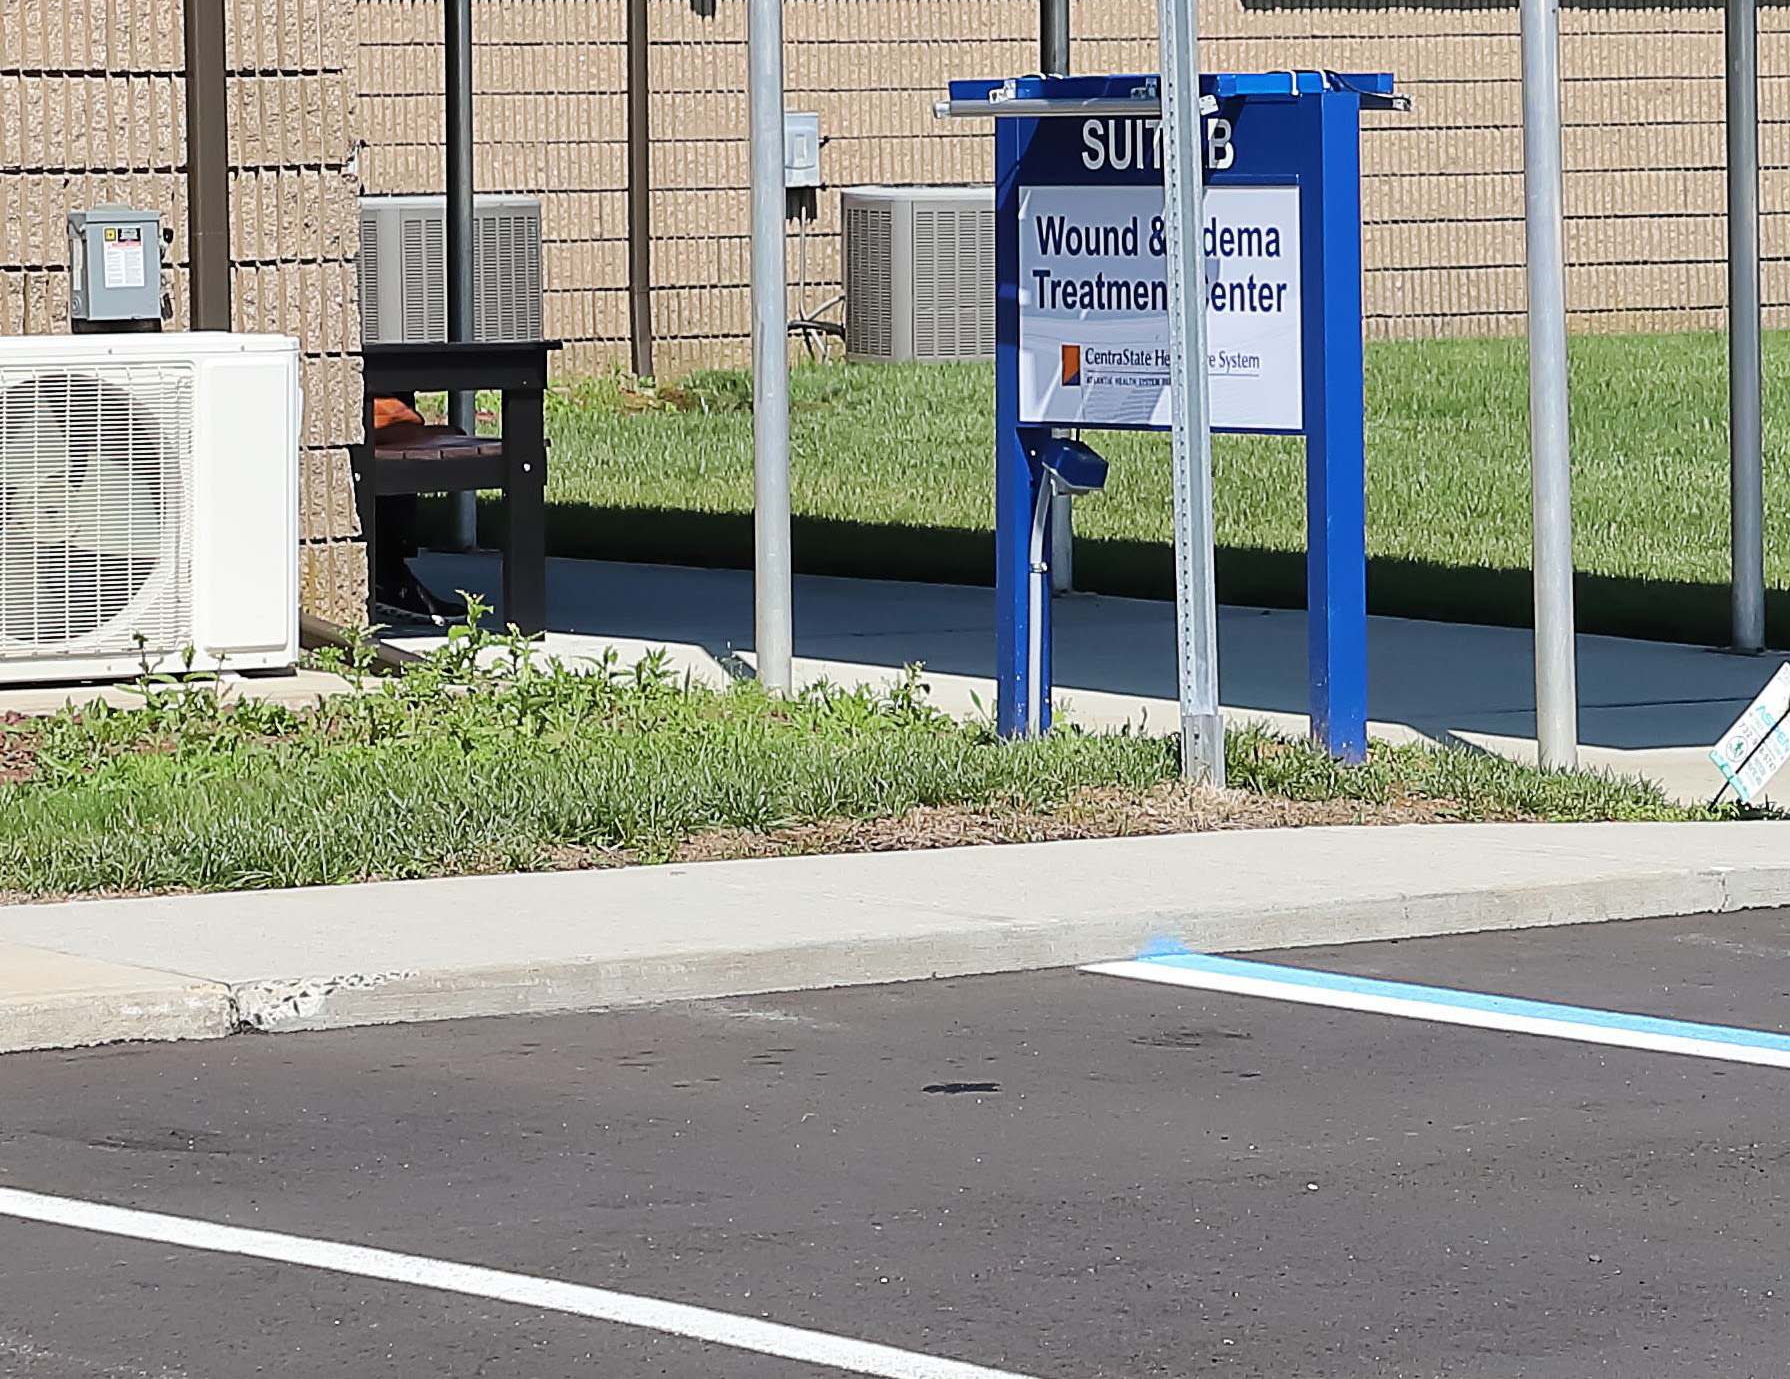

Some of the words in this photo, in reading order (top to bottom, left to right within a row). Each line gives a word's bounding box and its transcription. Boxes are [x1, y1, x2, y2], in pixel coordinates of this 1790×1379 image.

[1081, 119, 1163, 170] SUIT
[1207, 118, 1235, 169] B
[1036, 216, 1138, 258] Wound
[1149, 215, 1167, 257] &
[1203, 216, 1281, 258] dema
[1032, 269, 1168, 311] Treatmen
[1204, 273, 1287, 313] enter
[1085, 347, 1152, 367] CentraState
[1219, 350, 1260, 374] System
